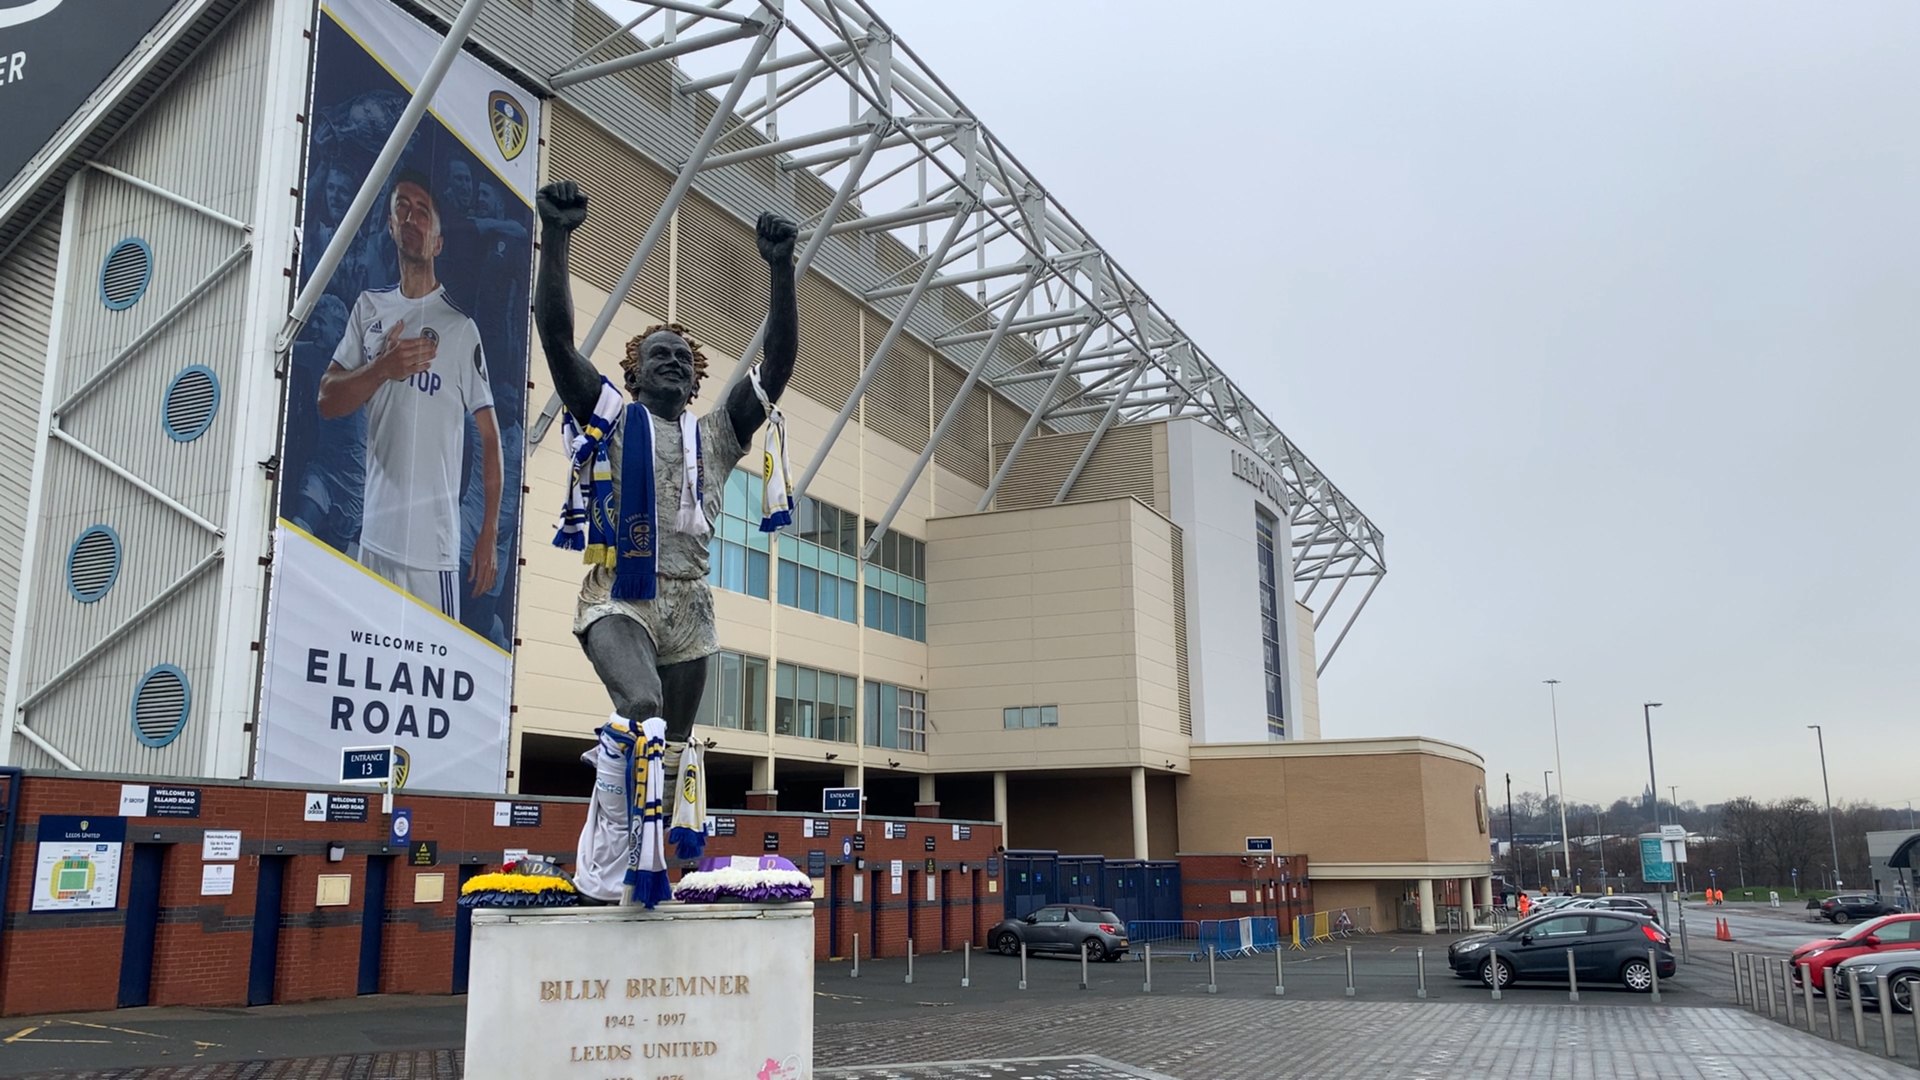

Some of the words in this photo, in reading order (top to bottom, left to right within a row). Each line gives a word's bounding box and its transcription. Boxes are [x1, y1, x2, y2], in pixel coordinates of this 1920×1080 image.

[350, 630, 424, 653] WELCOME
[430, 643, 448, 657] TO
[306, 648, 475, 702] ELLAND
[330, 695, 451, 740] ROAD
[350, 753, 384, 762] ENTRANCE
[361, 763, 373, 775] 13
[838, 799, 847, 807] 12
[539, 978, 610, 1002] BILLY
[626, 975, 751, 998] BREMNER
[605, 1013, 635, 1029] 1942
[657, 1013, 687, 1028] 1997
[570, 1044, 632, 1063] LEEDS
[643, 1040, 718, 1060] UNITED
